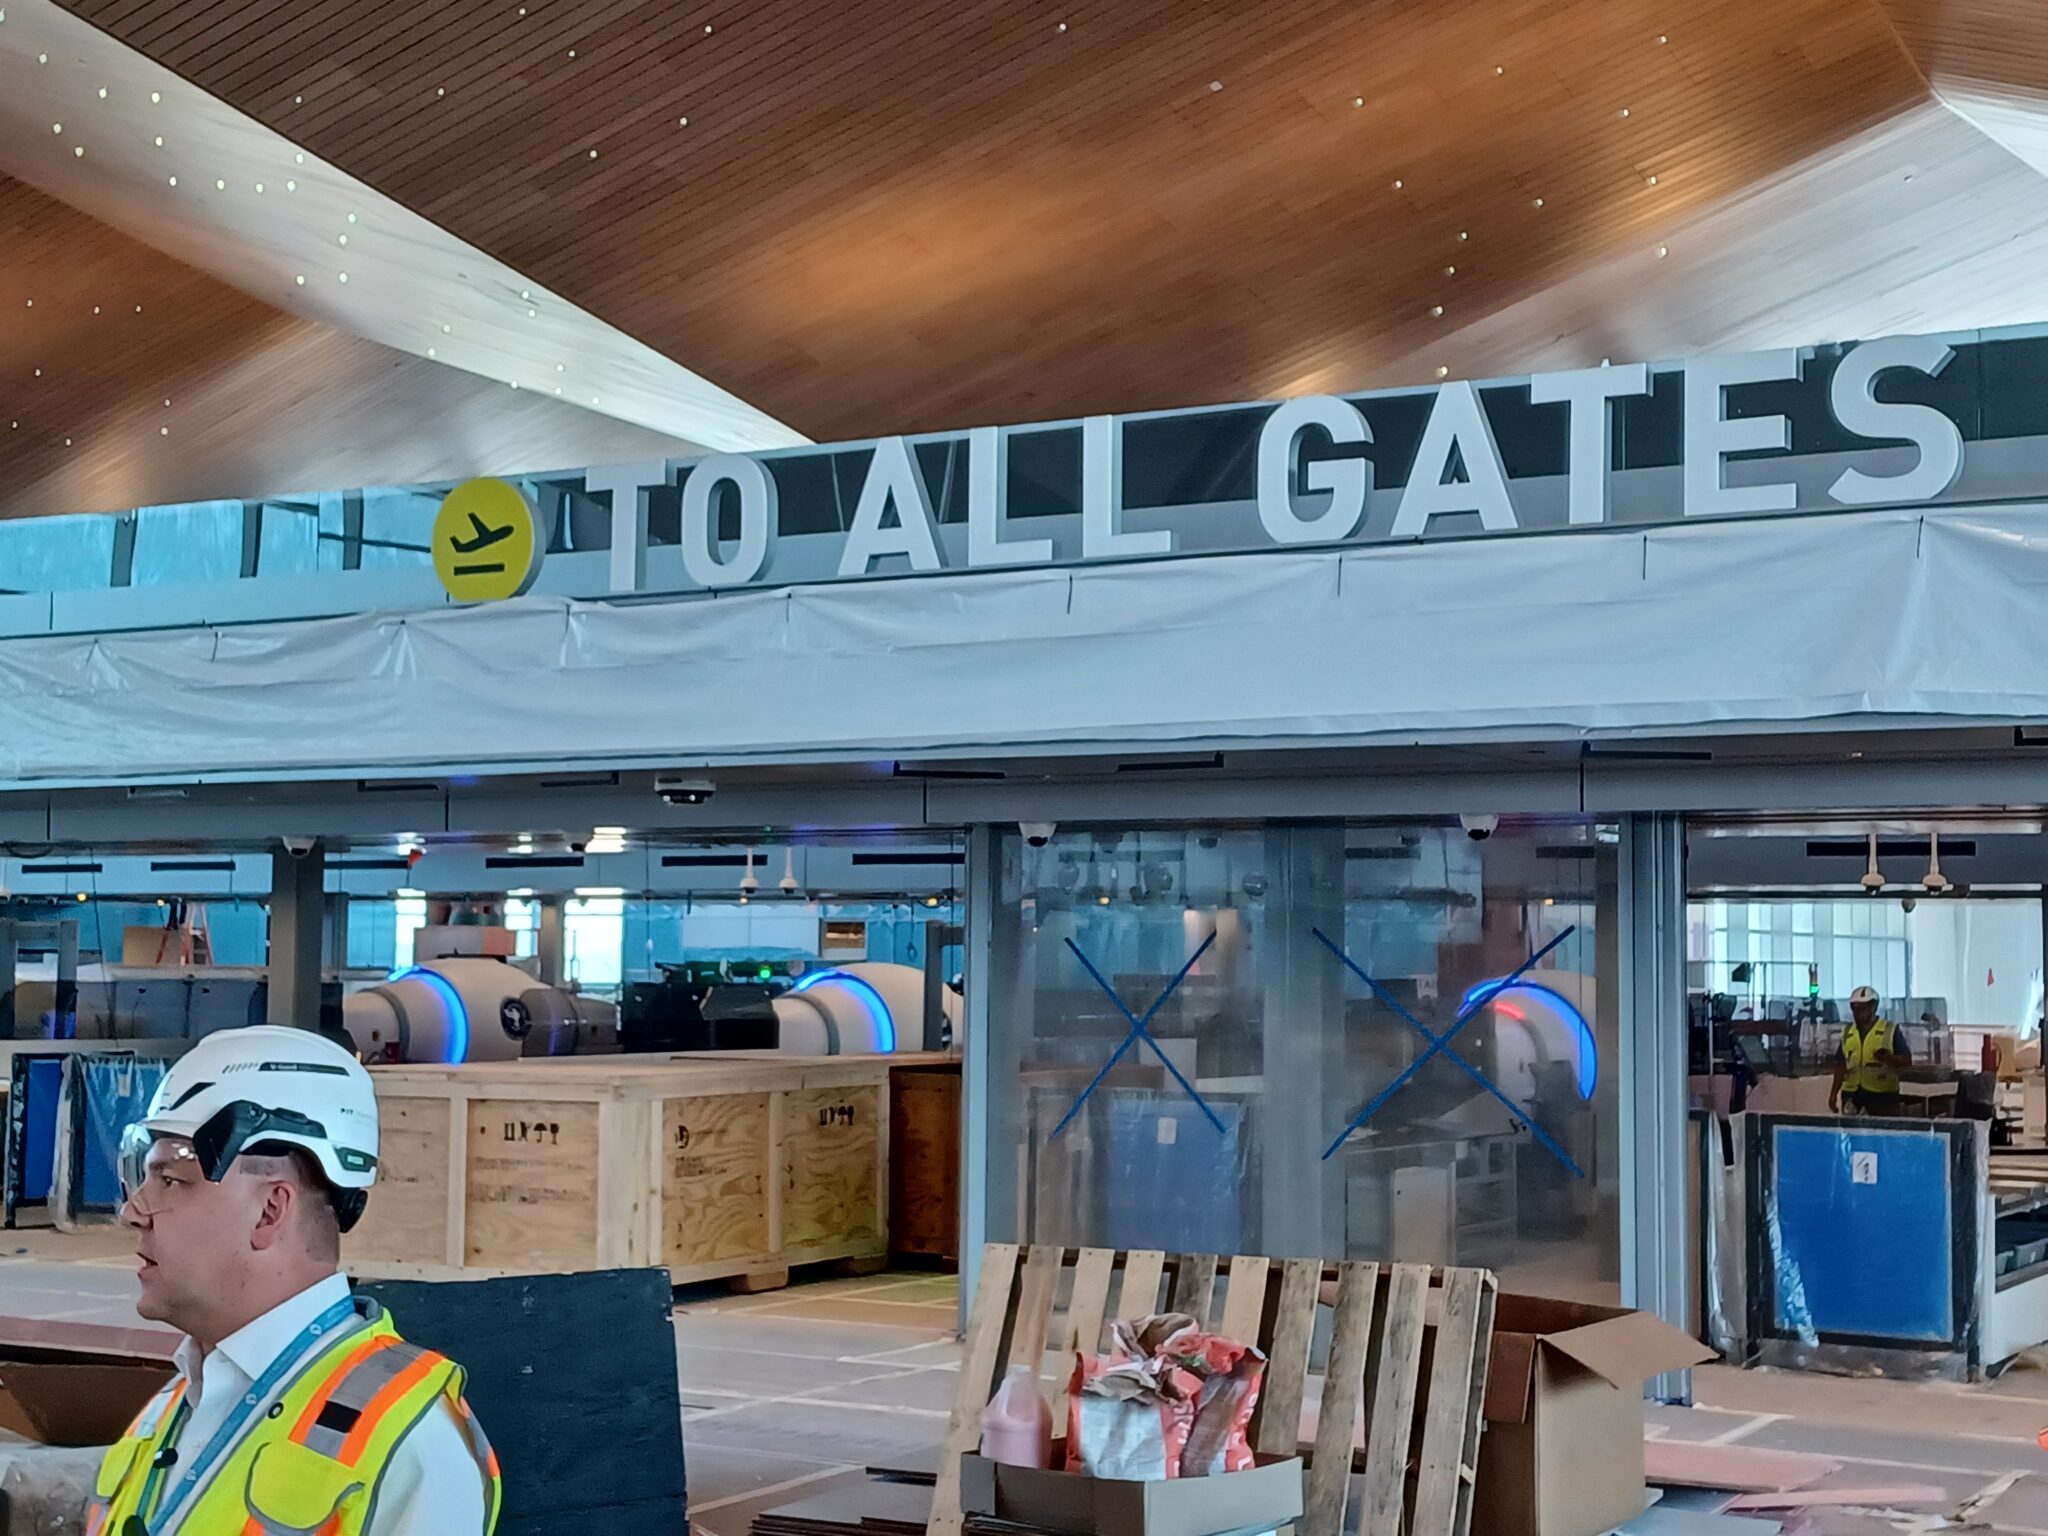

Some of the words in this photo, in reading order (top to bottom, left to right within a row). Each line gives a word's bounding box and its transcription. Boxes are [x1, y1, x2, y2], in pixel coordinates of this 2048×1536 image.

[585, 452, 777, 592] TO
[836, 415, 1173, 577] ALL
[1256, 334, 1966, 545] GATES
